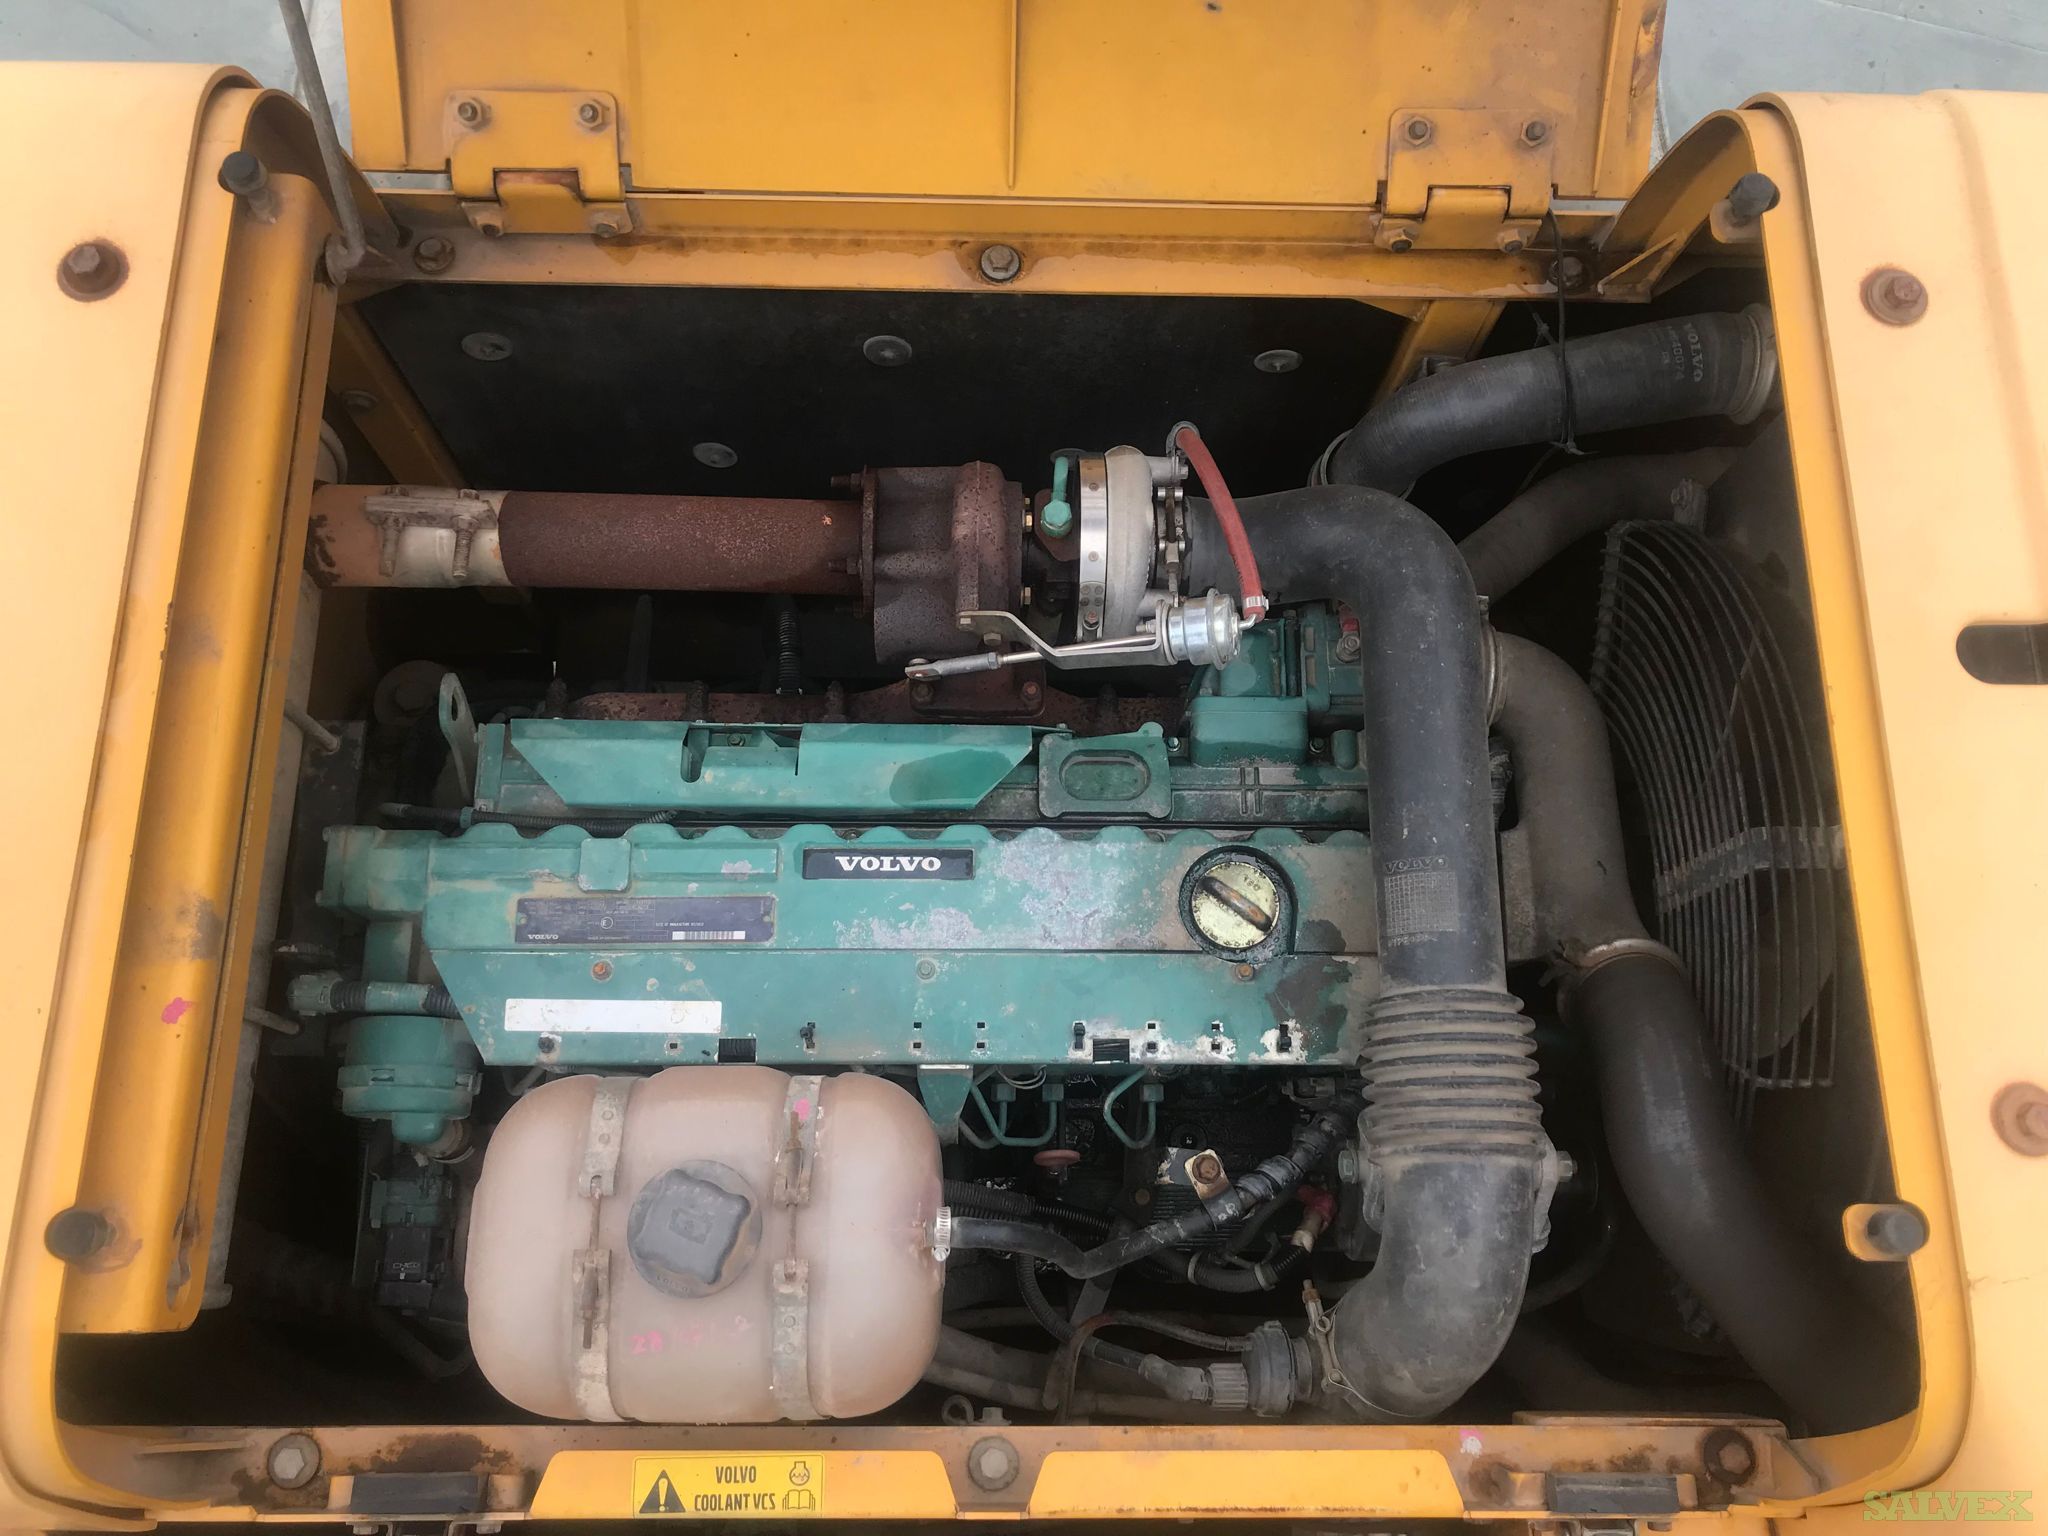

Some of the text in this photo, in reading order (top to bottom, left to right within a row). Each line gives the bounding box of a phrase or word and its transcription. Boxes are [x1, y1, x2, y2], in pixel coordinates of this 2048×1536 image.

[1684, 322, 1704, 382] VOLVO
[835, 856, 941, 872] VOLVO
[1385, 856, 1449, 874] VOLVO
[715, 1465, 757, 1484] VOLVO
[694, 1492, 776, 1512] COOLANT VCS
